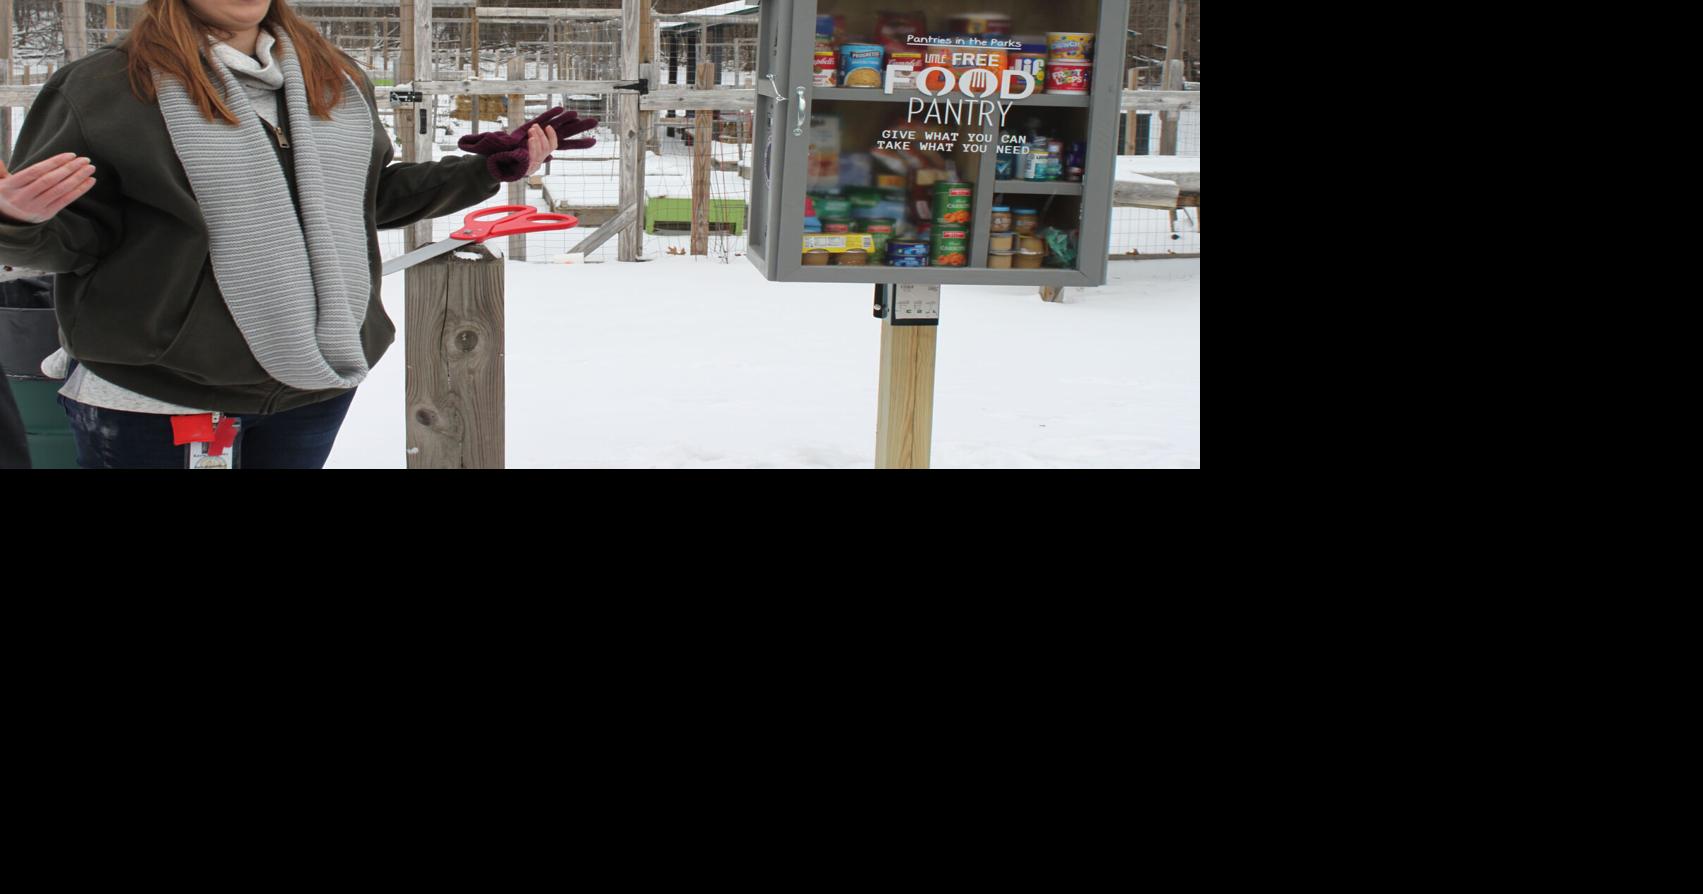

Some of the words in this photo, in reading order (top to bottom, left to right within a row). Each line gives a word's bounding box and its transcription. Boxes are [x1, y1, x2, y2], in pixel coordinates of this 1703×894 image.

[907, 35, 952, 45] Pantries
[969, 38, 987, 46] the
[990, 39, 1022, 48] Parks
[925, 53, 946, 64] LITTLE
[952, 53, 1000, 67] FREE
[884, 65, 1036, 99] FOOD
[907, 97, 1013, 127] PANTRY
[882, 130, 916, 140] GIVE
[924, 131, 959, 142] WHAT
[968, 133, 993, 142] YOU
[1001, 134, 1027, 144] CAN
[877, 141, 911, 150] TAKE
[919, 142, 954, 152] WHAT
[963, 143, 988, 153] YOU
[996, 145, 1030, 154] NEED
